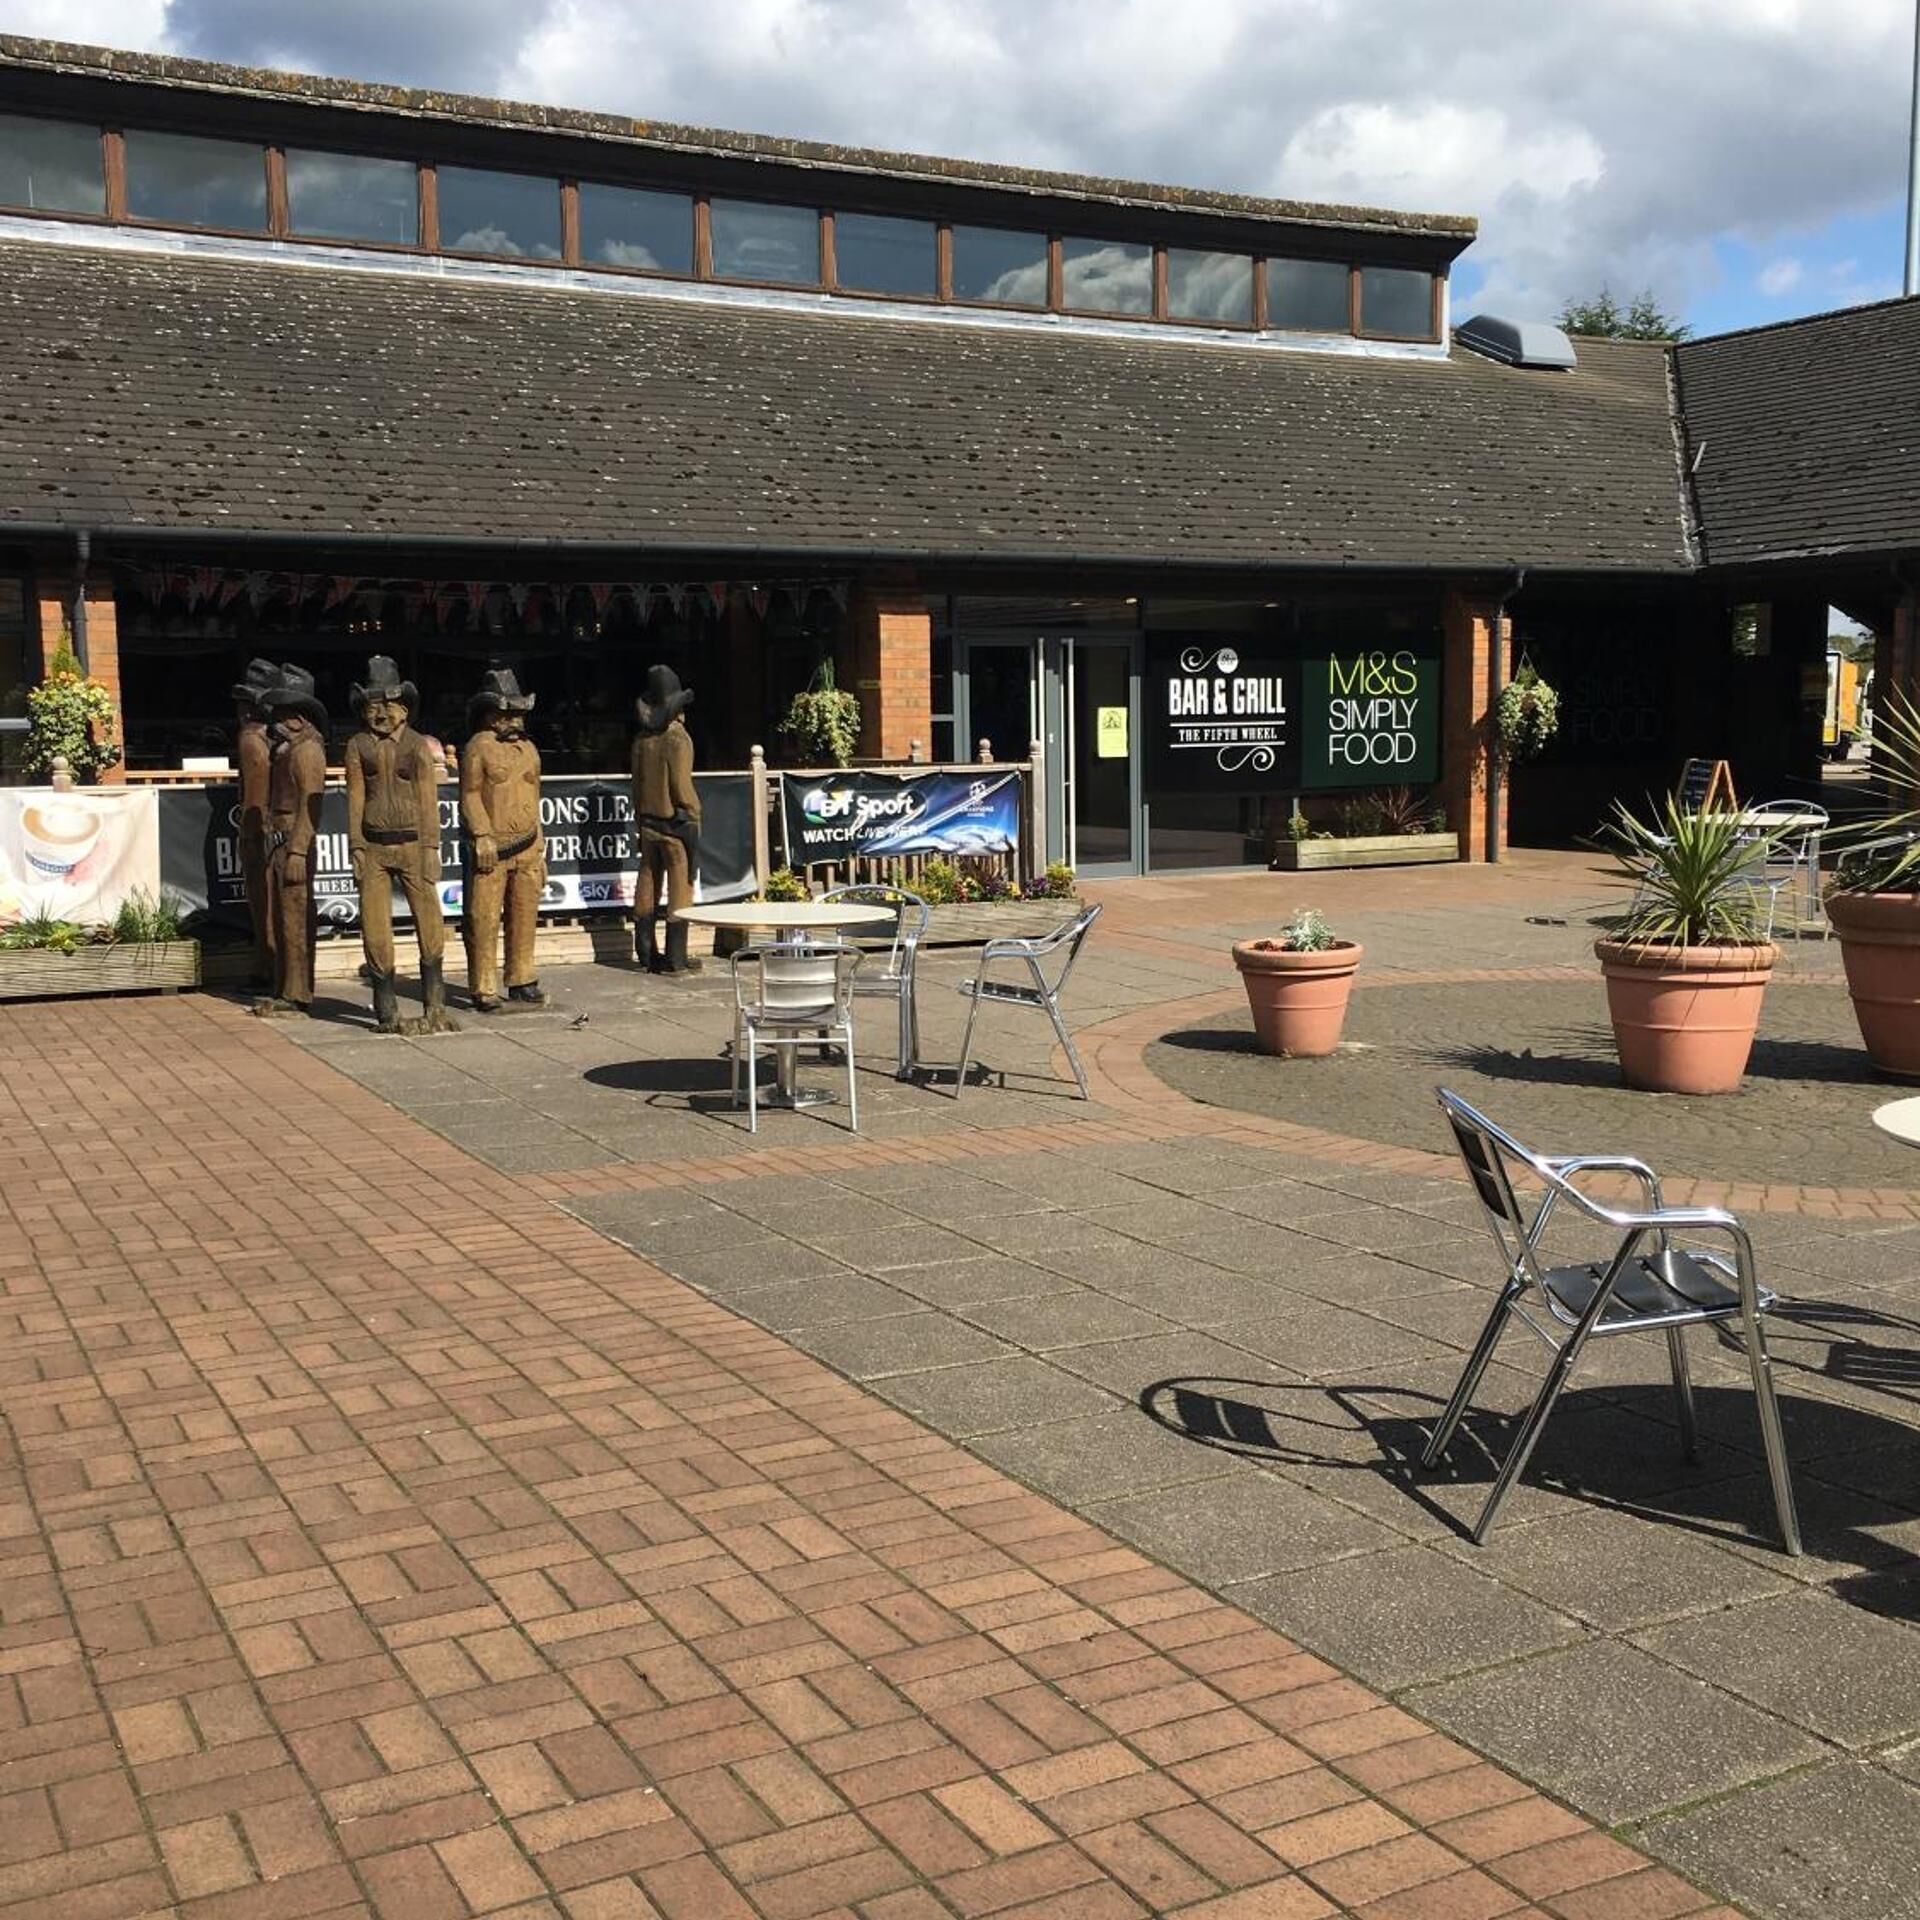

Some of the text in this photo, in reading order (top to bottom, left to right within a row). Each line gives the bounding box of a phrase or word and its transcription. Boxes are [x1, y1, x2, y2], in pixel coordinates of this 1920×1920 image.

[1329, 651, 1418, 695] M&S
[1169, 677, 1286, 716] BAR & GRILL
[1328, 698, 1419, 731] SIMPLY
[1179, 726, 1278, 742] THE FIFTH WHEEL
[1328, 732, 1417, 765] FOOD
[856, 793, 914, 819] Sport
[802, 827, 854, 844] WATCH
